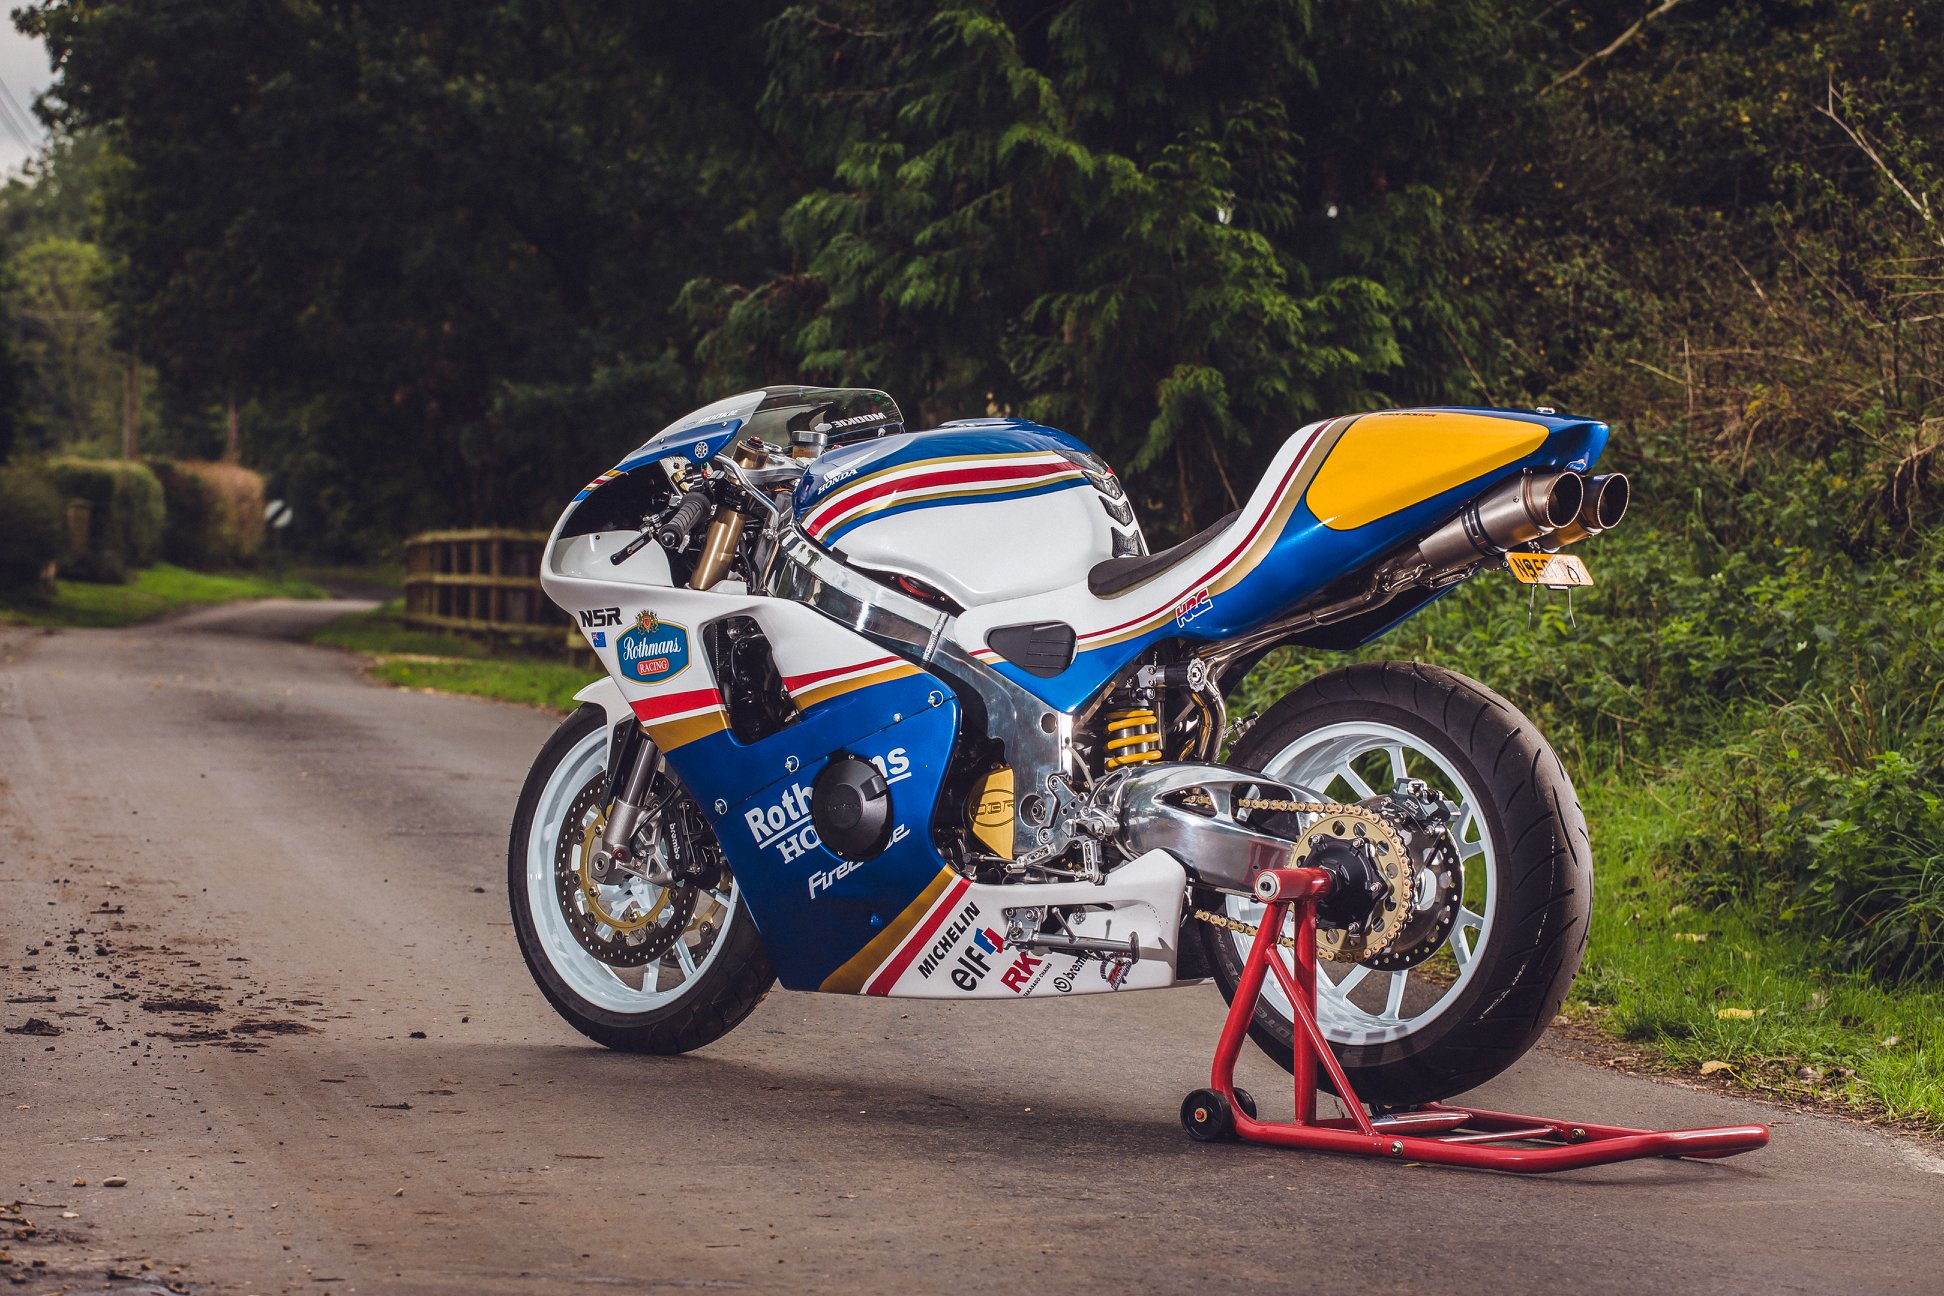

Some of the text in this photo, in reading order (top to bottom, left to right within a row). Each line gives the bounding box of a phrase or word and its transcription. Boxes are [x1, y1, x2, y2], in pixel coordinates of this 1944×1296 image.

[817, 469, 858, 495] HONDA
[579, 607, 622, 627] NSR
[1175, 587, 1213, 628] HRC
[623, 637, 681, 660] Rothmans
[639, 660, 668, 673] RACING
[744, 747, 911, 843] Rothns
[669, 822, 680, 860] brembo
[918, 901, 980, 979] MICHELIN
[951, 945, 991, 991] elf
[1000, 951, 1043, 994] RK
